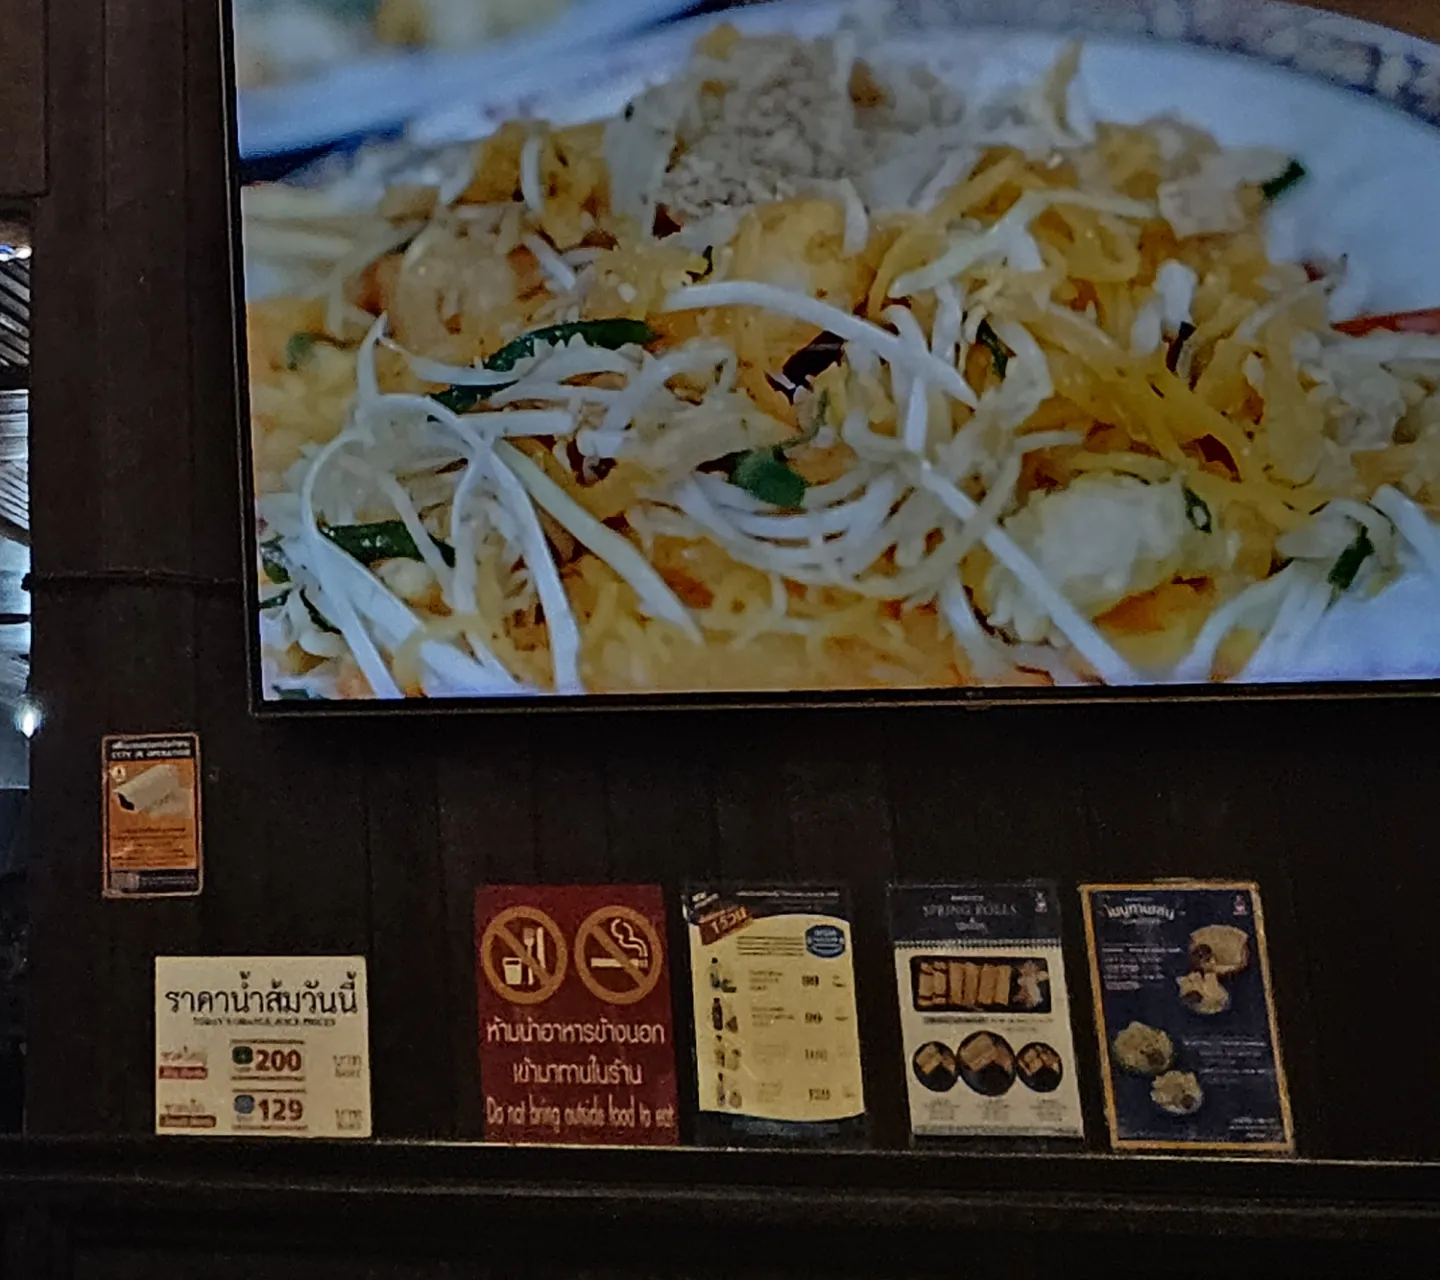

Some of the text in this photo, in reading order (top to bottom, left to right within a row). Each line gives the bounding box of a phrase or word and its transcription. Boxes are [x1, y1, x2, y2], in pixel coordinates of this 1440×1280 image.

[165, 970, 358, 1014] ราคาน้ำส้มวันนี้
[487, 1016, 665, 1045] ห้ามนำอาหารข้างนอก
[255, 1048, 302, 1073] 200
[513, 1054, 642, 1084] เข้ามาทานในร้าน
[258, 1098, 304, 1122] 129
[486, 1095, 503, 1125] Do
[507, 1100, 526, 1125] not
[528, 1093, 560, 1133] bring
[564, 1093, 605, 1126] outside
[608, 1093, 636, 1127] food
[639, 1101, 652, 1127] to
